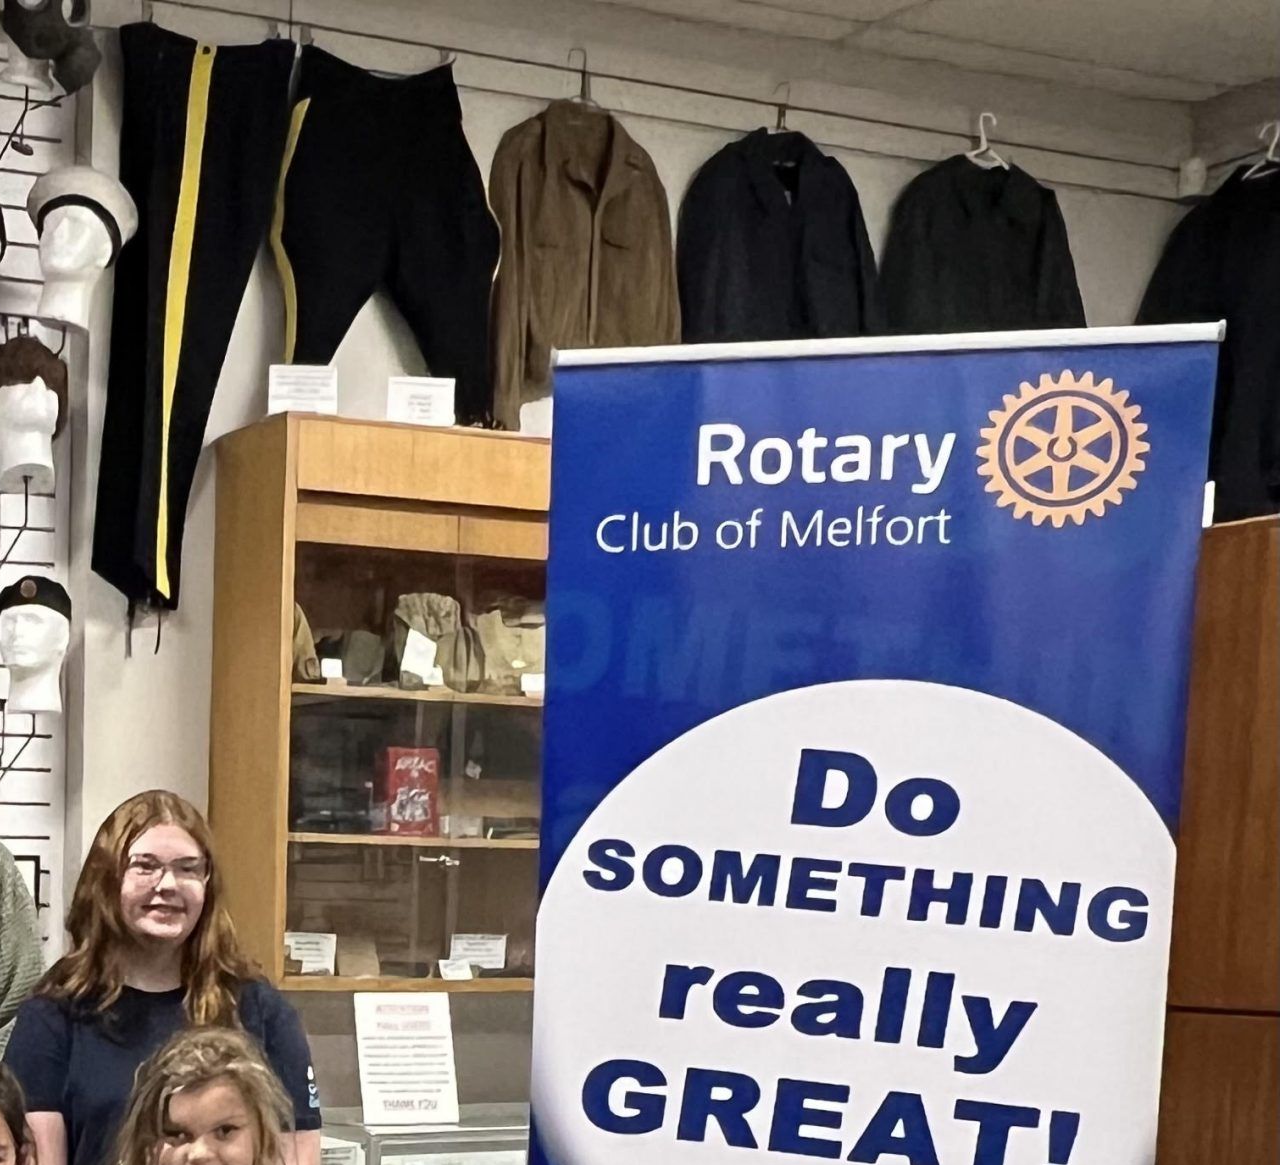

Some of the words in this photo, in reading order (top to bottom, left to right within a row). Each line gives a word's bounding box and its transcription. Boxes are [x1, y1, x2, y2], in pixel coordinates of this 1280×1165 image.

[697, 423, 957, 494] Rotary
[596, 510, 699, 553] Club
[715, 507, 764, 550] of
[780, 504, 952, 548] Melfort
[790, 748, 961, 837] Do
[582, 837, 1150, 944] SOMETHING
[658, 964, 1039, 1074] really
